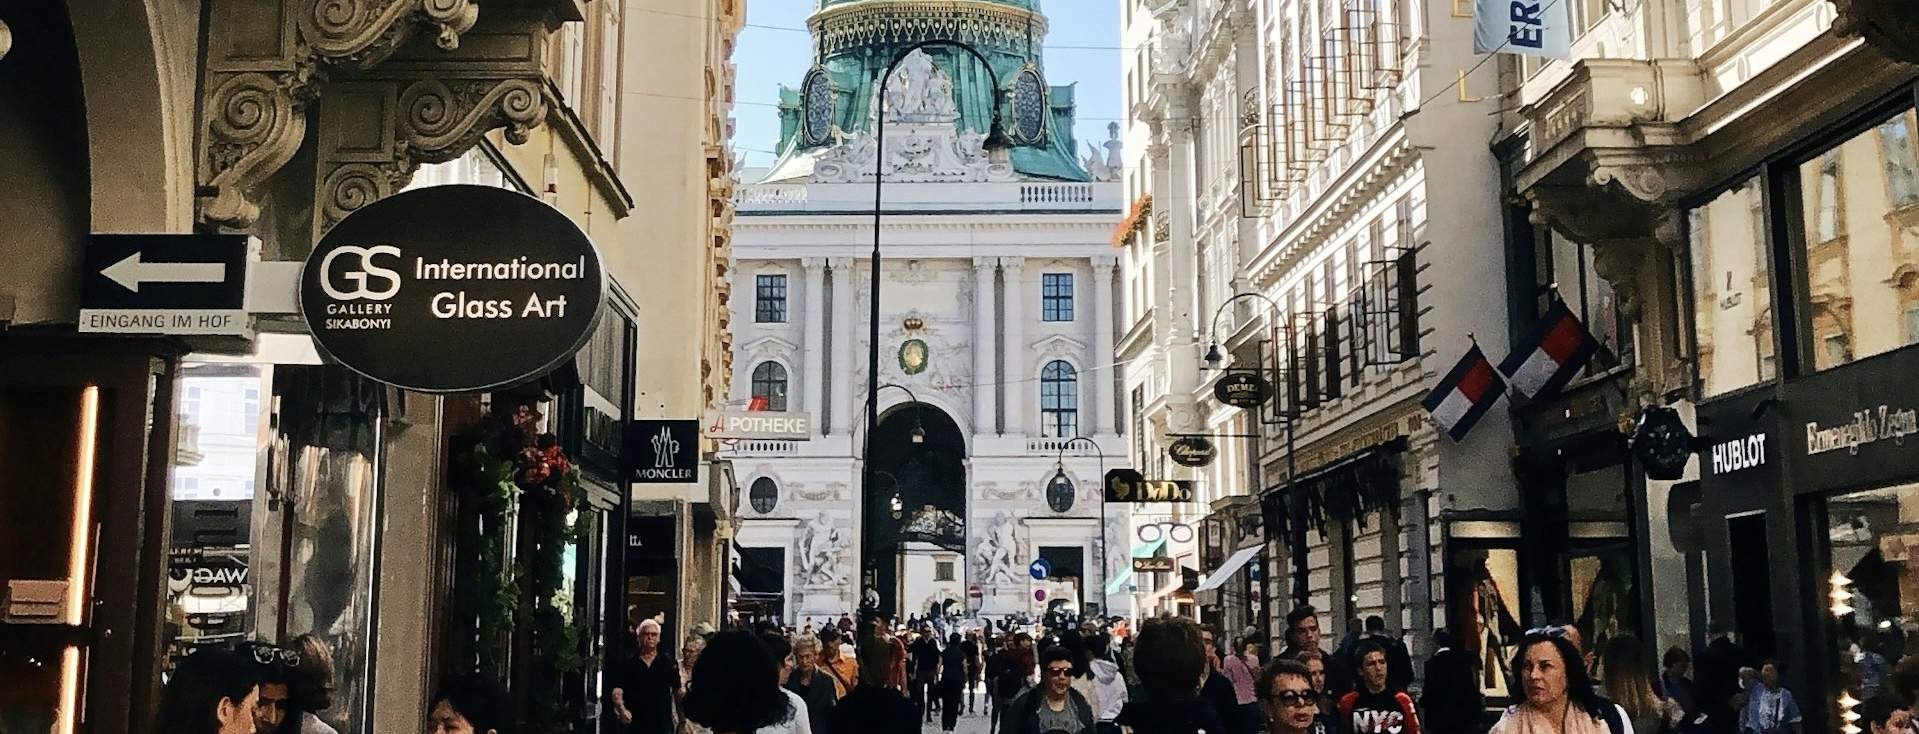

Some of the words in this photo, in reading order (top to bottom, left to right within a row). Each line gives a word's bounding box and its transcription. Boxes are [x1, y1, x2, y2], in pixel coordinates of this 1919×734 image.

[1510, 0, 1542, 48] ER
[320, 244, 401, 301] GS
[416, 254, 585, 280] International
[327, 303, 392, 315] GALLERY
[431, 291, 513, 319] Glass
[521, 292, 567, 318] Art
[90, 314, 165, 328] EINGANG
[172, 315, 192, 328] IM
[199, 315, 232, 328] HOF
[326, 318, 391, 330] SIKABONYI
[1713, 433, 1766, 474] HUBLOT
[636, 468, 692, 479] MONCLER
[1353, 710, 1403, 734] NYC
